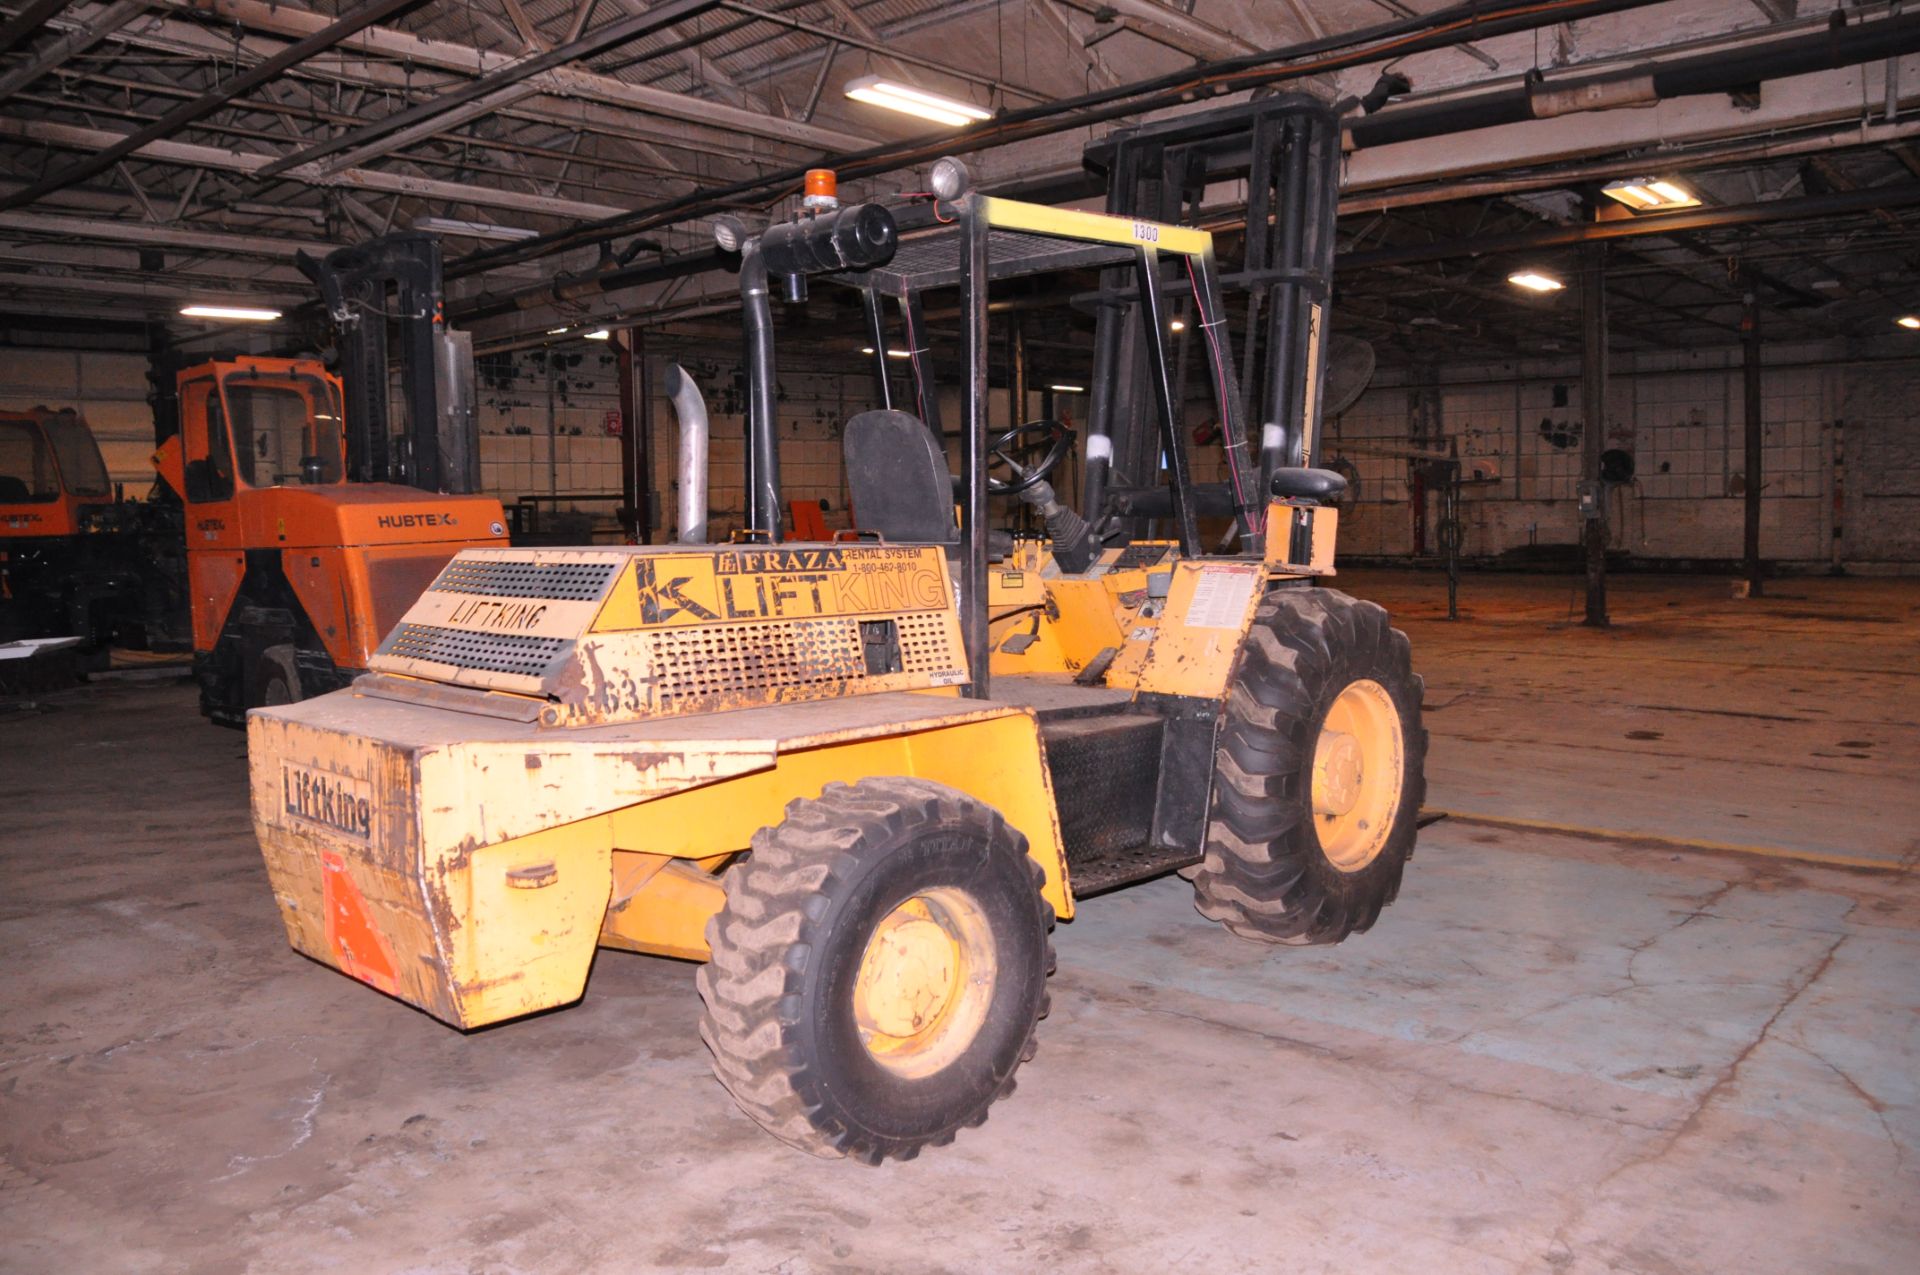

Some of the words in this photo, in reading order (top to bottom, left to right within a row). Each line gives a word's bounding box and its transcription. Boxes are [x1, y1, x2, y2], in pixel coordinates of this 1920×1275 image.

[1134, 223, 1158, 242] 1300
[378, 513, 453, 529] HUBTEX
[744, 550, 842, 571] FRAZA
[885, 548, 922, 559] SYSTEM
[448, 600, 547, 629] LIFTKING
[929, 669, 964, 679] HYDRAULIC
